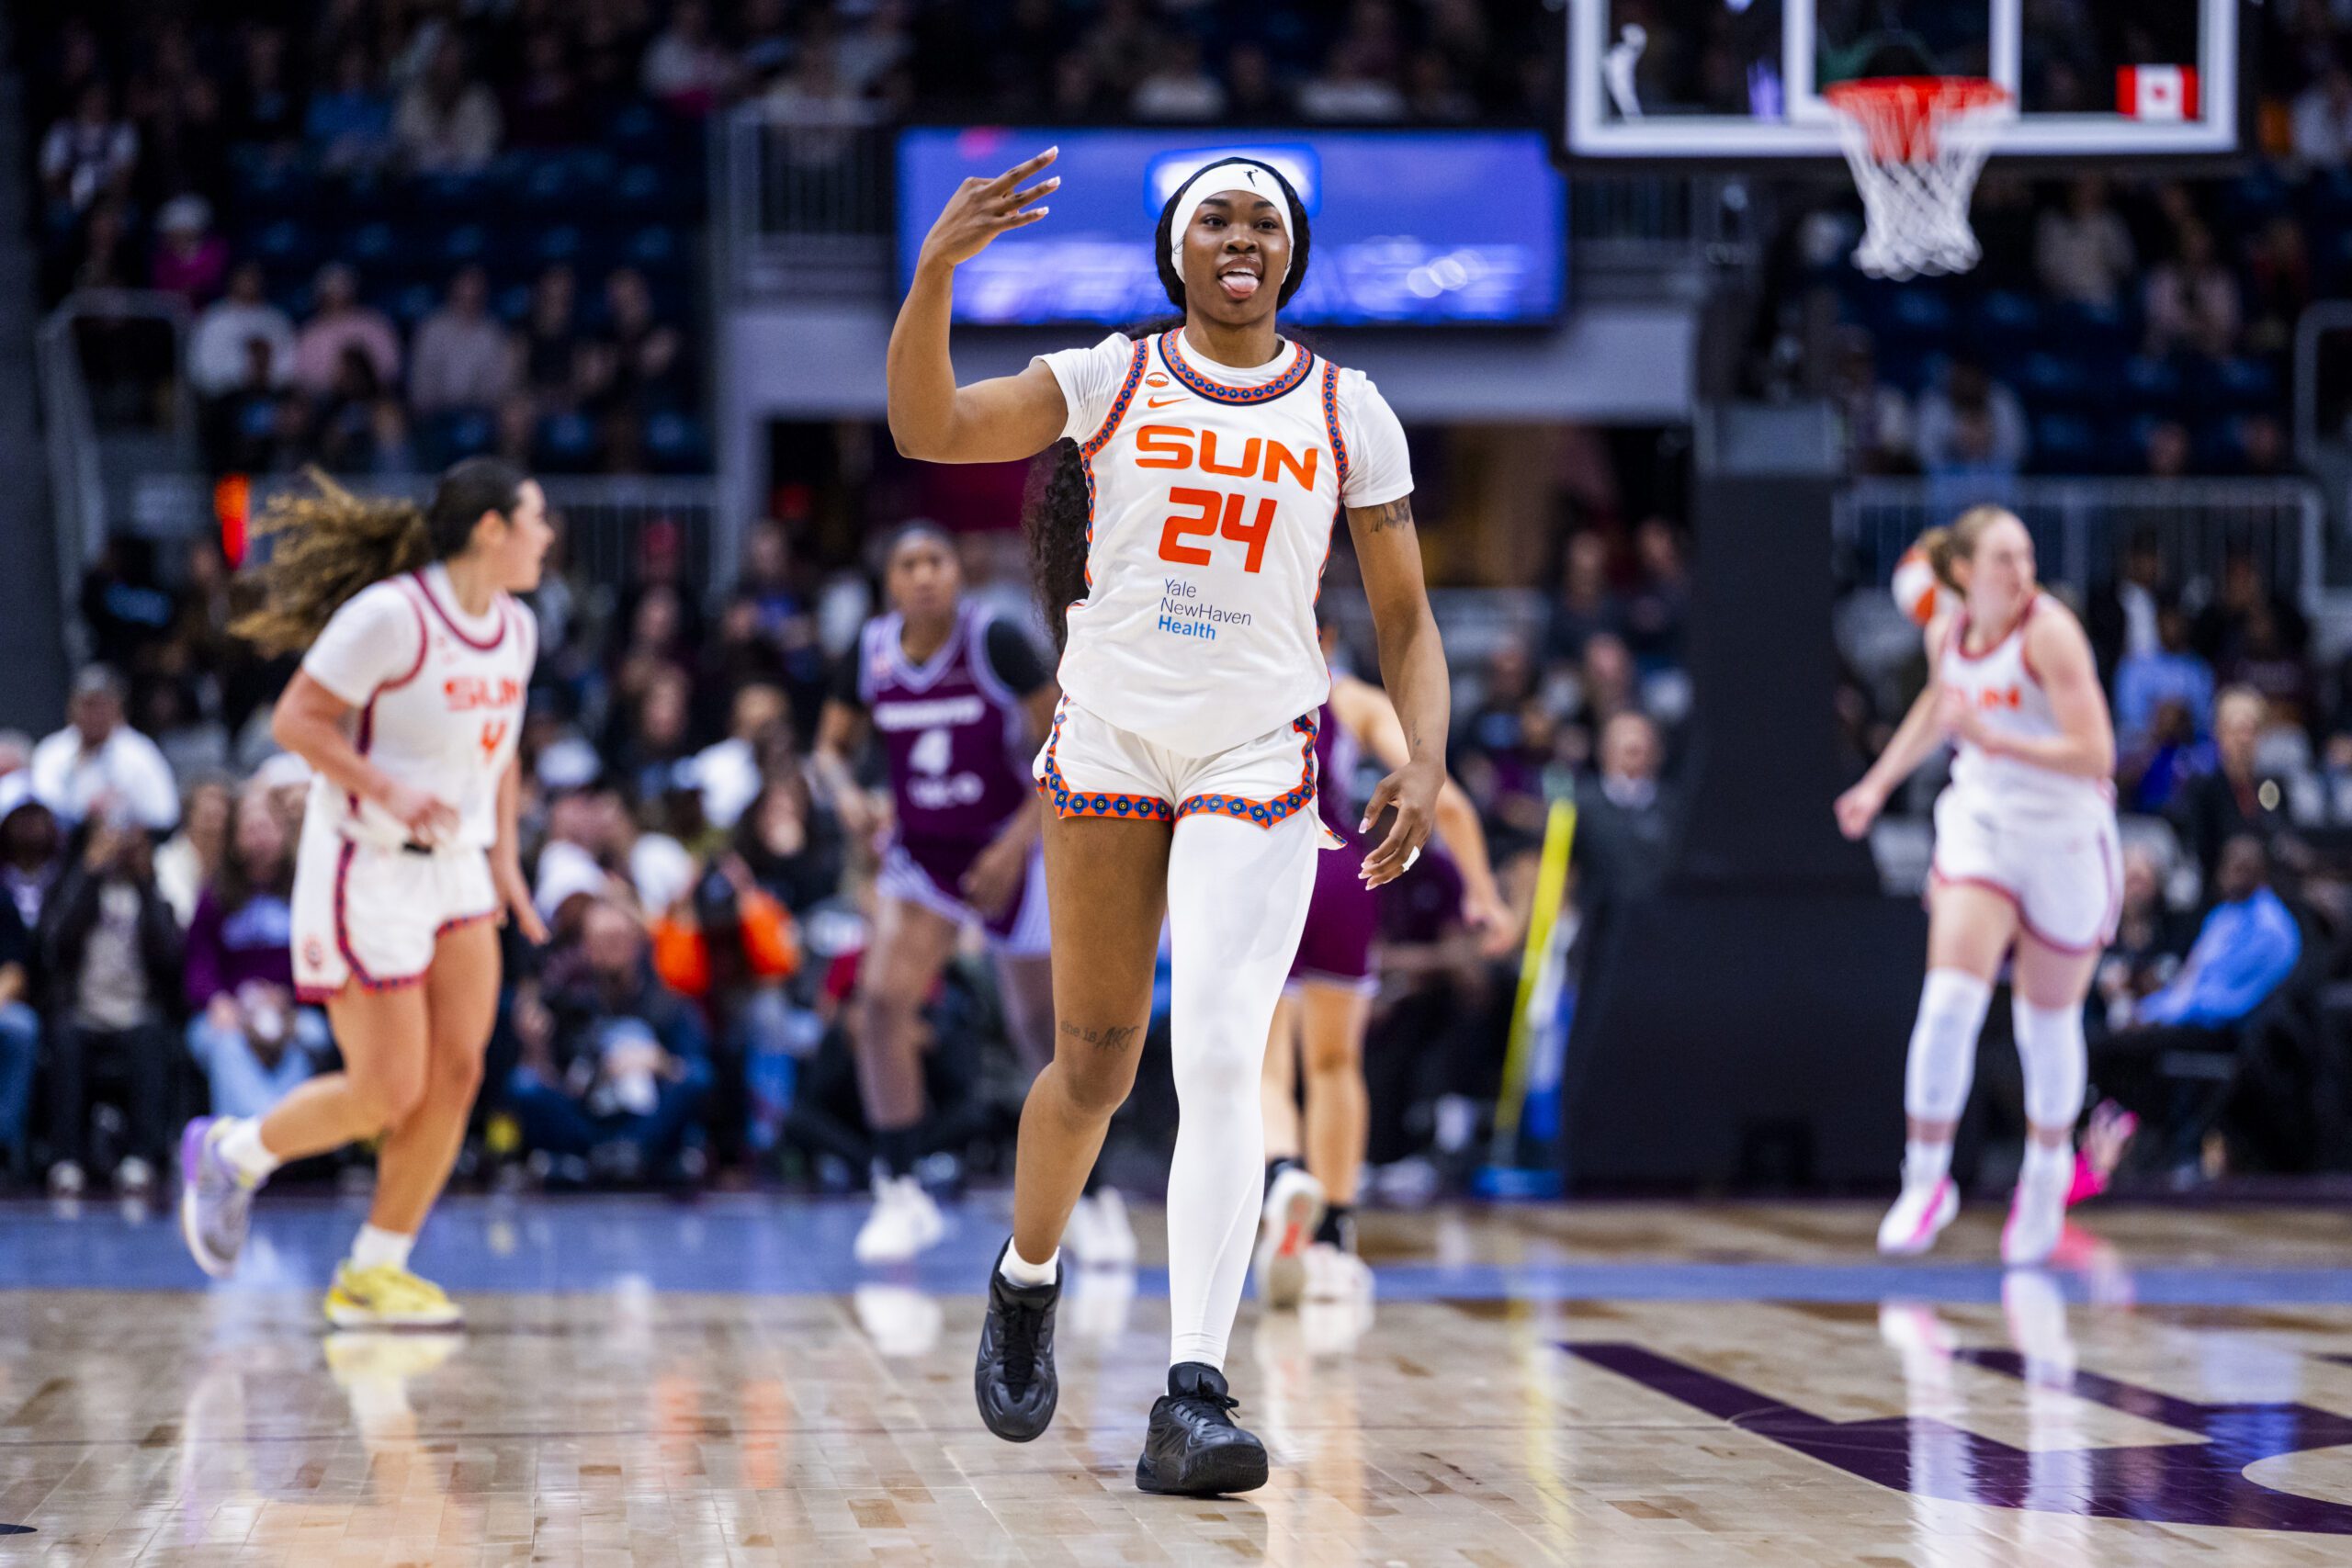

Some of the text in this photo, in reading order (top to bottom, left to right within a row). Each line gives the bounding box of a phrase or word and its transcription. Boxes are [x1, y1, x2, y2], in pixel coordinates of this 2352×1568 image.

[1136, 424, 1317, 491] SUN
[1158, 487, 1277, 573] 24
[1164, 579, 1197, 598] Yale
[1158, 615, 1216, 640] Health
[1160, 598, 1252, 626] NewHaven
[909, 728, 953, 775] 4
